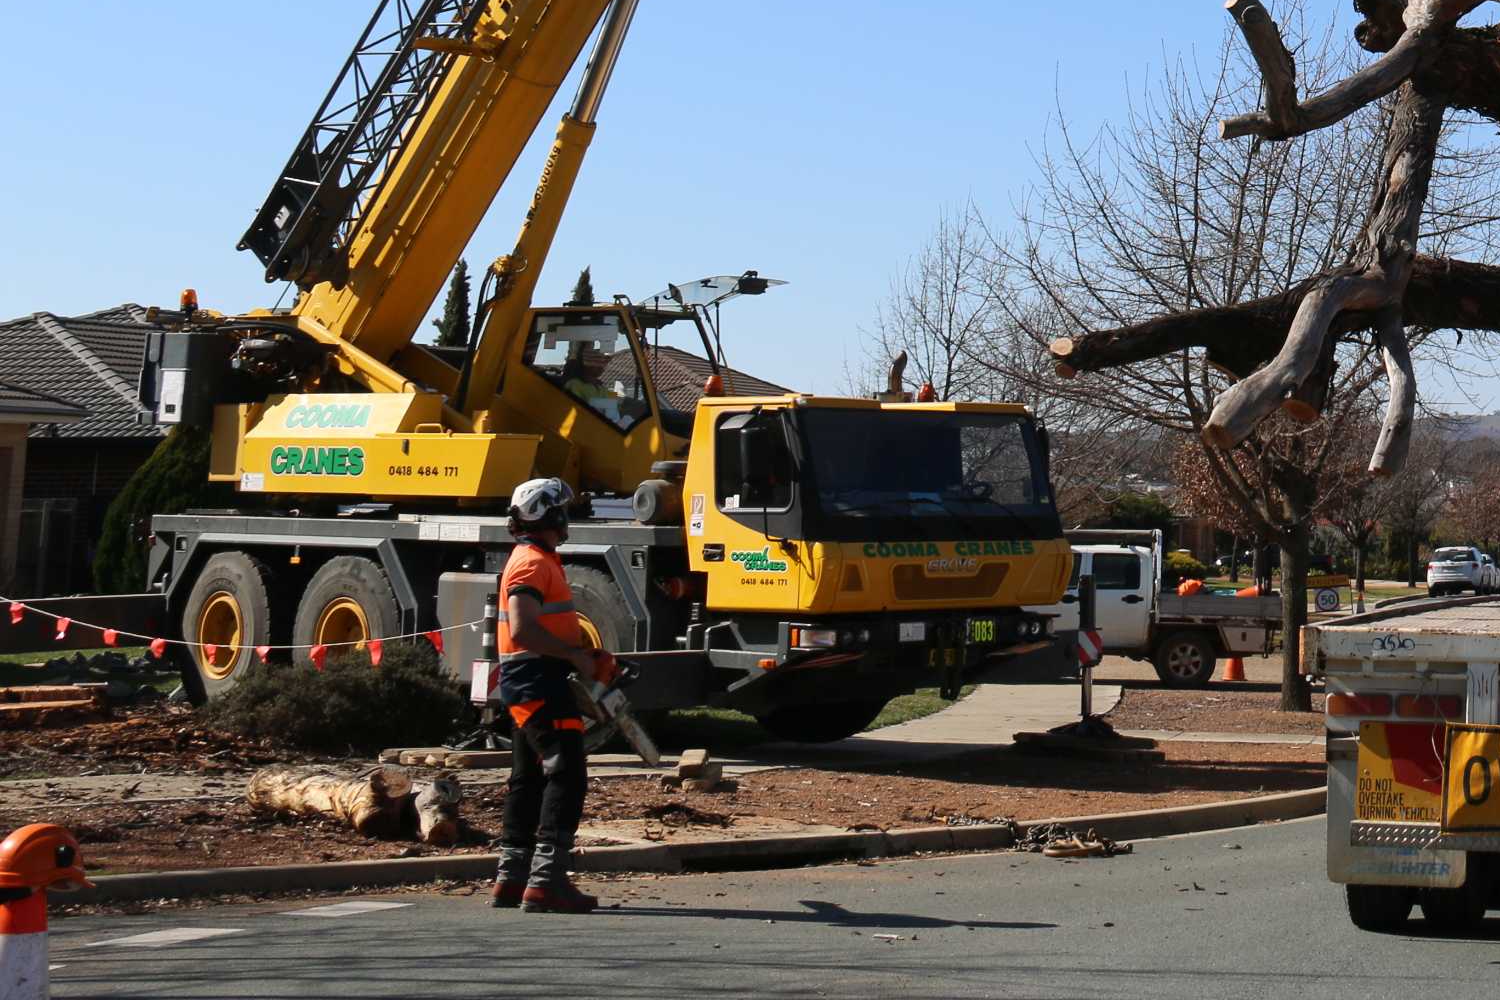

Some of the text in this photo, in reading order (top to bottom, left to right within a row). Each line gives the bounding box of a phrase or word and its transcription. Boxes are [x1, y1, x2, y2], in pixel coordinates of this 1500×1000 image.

[270, 446, 365, 476] CRANES
[388, 465, 459, 477] 0418 484 171
[863, 539, 1036, 558] COOMA CRANES
[740, 577, 757, 586] 0418
[777, 578, 788, 586] 171
[1320, 594, 1336, 606] 50
[1359, 778, 1393, 791] DO NOT
[1359, 791, 1404, 806] OVERTAKE
[1359, 805, 1397, 819] TURNING
